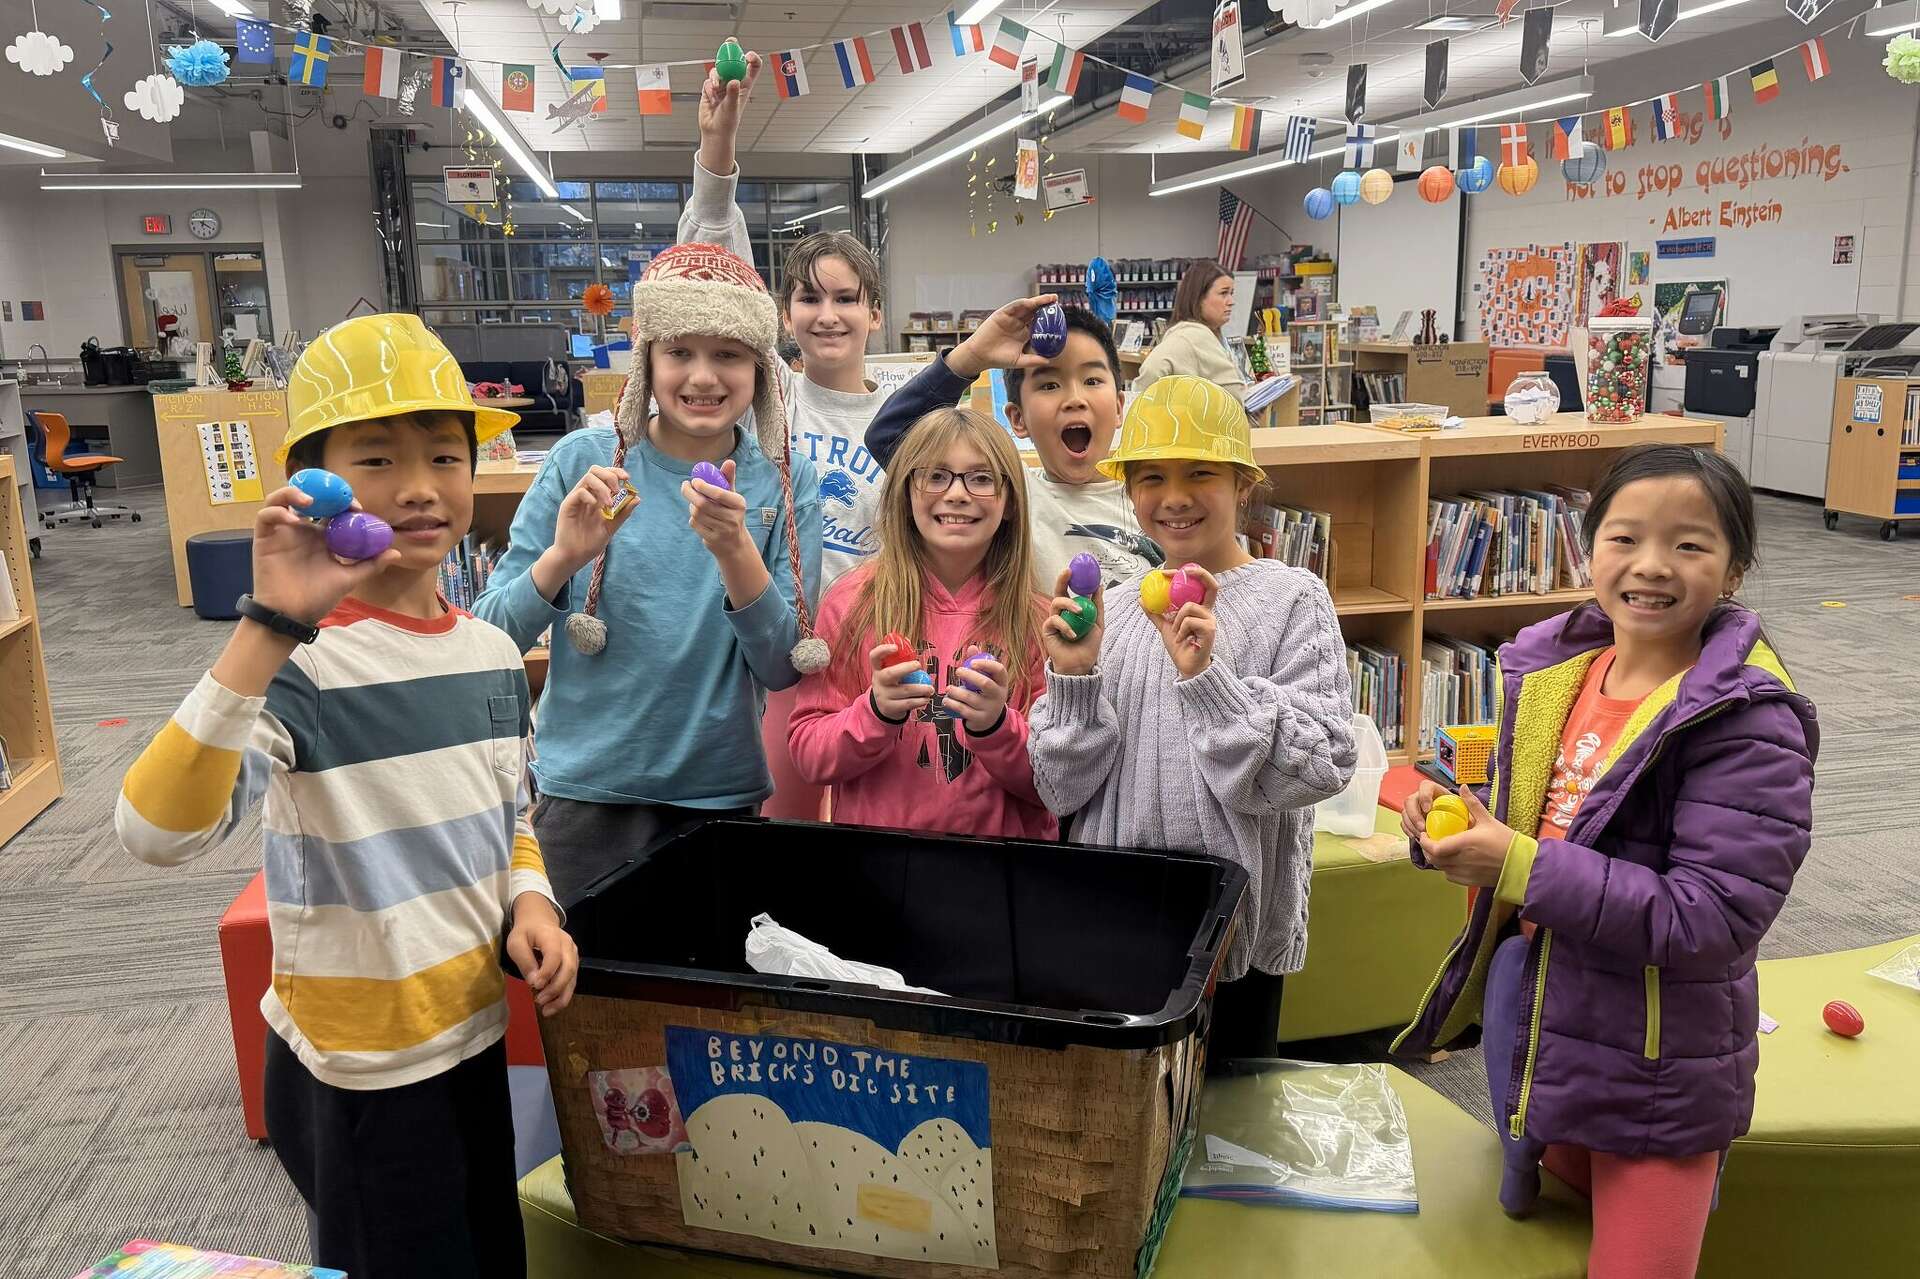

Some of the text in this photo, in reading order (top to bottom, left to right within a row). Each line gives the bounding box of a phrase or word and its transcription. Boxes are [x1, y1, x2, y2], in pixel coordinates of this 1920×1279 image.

[1605, 169, 1625, 197] to
[1637, 163, 1683, 200] stop
[1696, 135, 1850, 193] questioning.
[1662, 206, 1711, 234] Albert
[1719, 198, 1783, 228] Einstein
[880, 371, 905, 381] How
[159, 395, 202, 404] FICTION
[237, 391, 280, 401] FICTION
[248, 402, 257, 410] H
[264, 401, 272, 409] R
[1523, 434, 1600, 448] EVERYBOD
[708, 1037, 911, 1079] BEYOND THE
[711, 1061, 815, 1085] BRICKS
[890, 1083, 955, 1104] SITE
